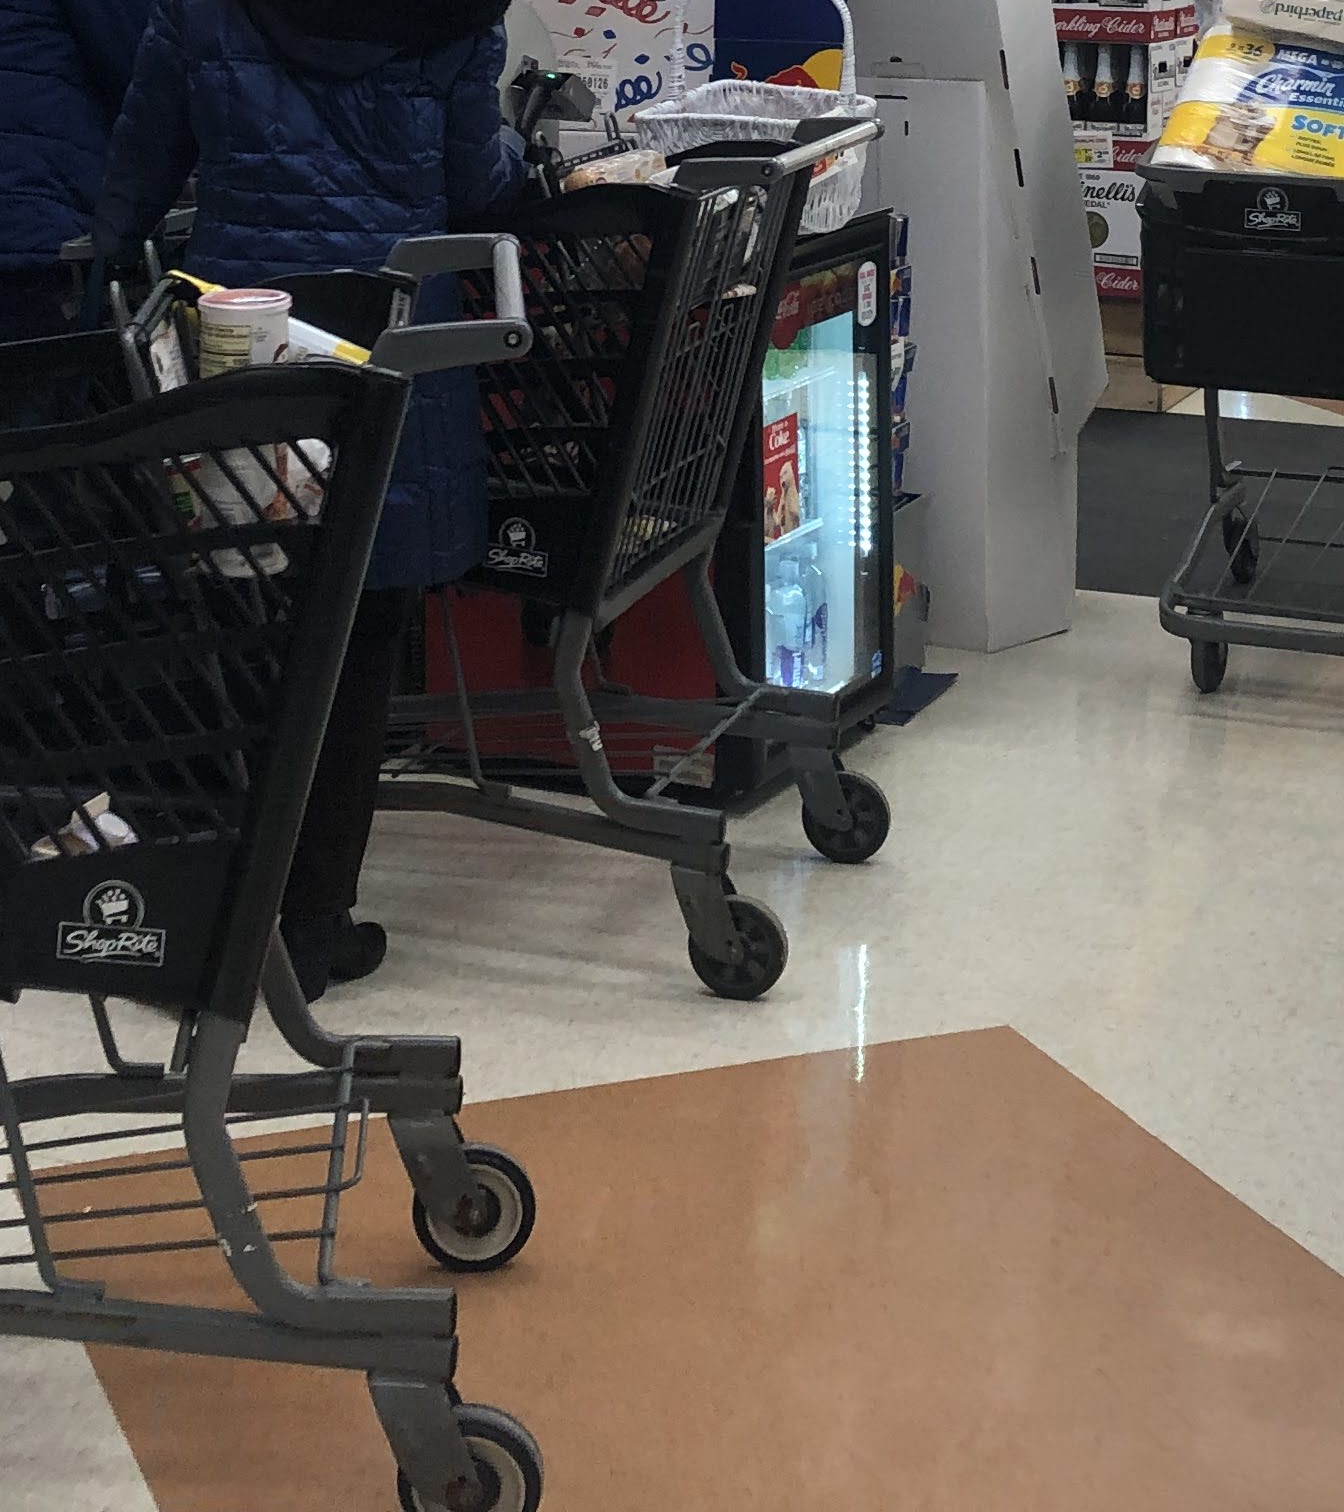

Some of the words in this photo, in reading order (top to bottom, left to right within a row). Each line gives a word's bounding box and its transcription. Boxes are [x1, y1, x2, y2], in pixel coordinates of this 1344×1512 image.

[1273, 2, 1344, 22] paperbird
[1102, 15, 1146, 35] Cider
[1276, 48, 1318, 66] MEGA
[1255, 73, 1337, 98] Charmin
[1247, 211, 1300, 228] ShopRite
[1096, 270, 1139, 292] Cider
[768, 429, 790, 451] Coke
[486, 546, 546, 572] ShopRite
[63, 928, 162, 958] ShopRite
